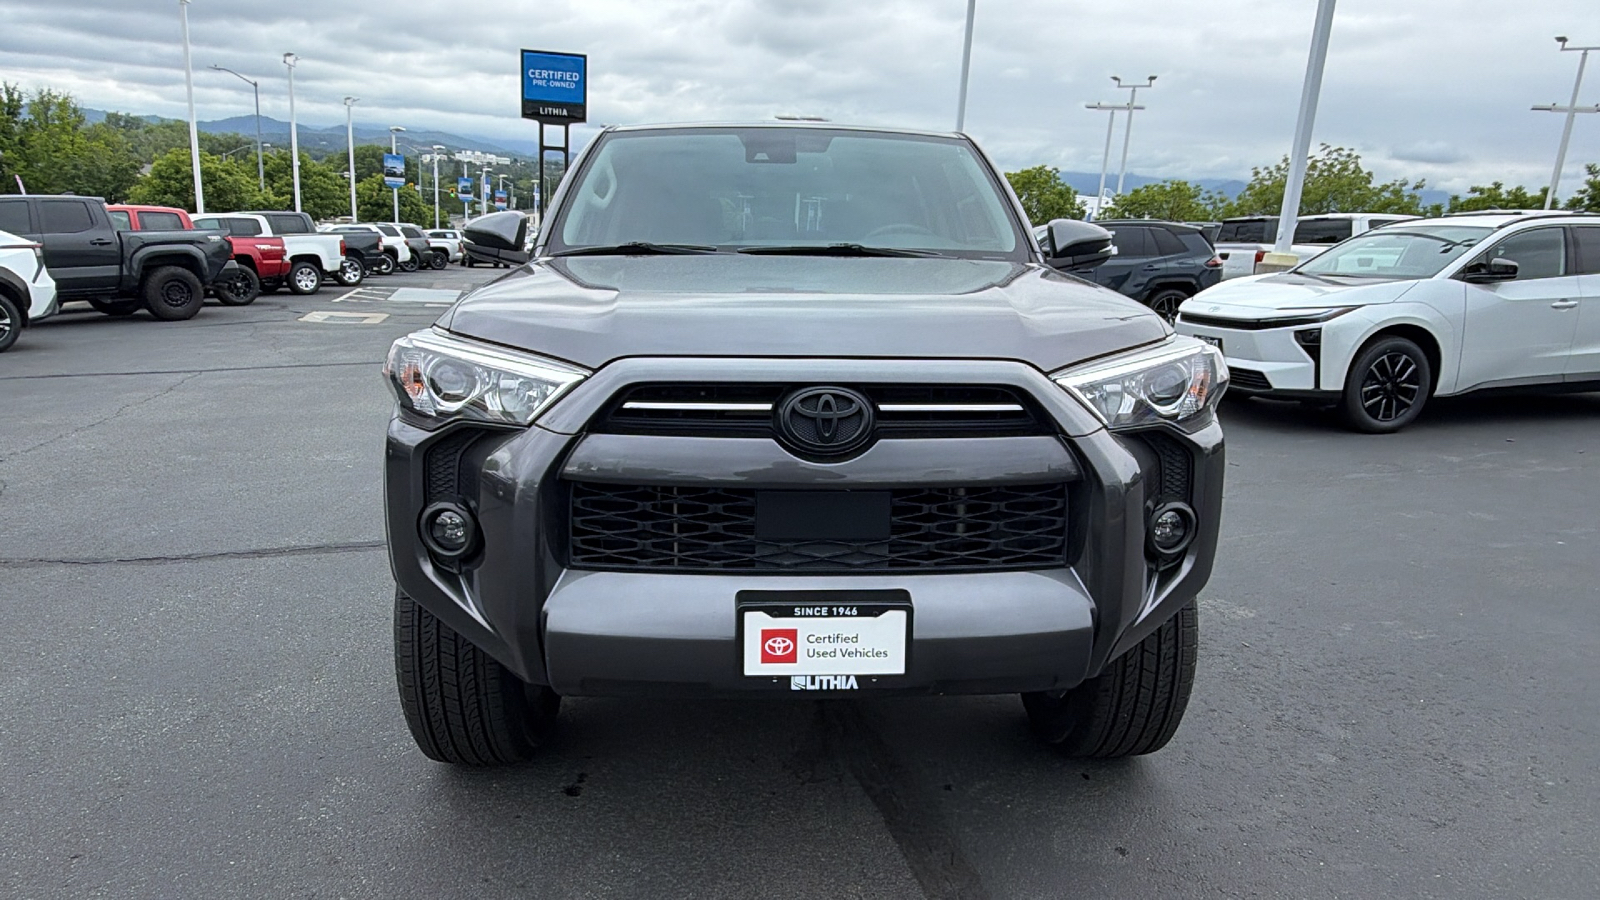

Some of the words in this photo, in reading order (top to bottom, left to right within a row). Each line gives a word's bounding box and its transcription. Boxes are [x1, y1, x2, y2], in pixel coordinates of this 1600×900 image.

[528, 69, 580, 81] CERTIFIED
[533, 79, 575, 88] PRE-OWNED
[539, 107, 568, 116] LITHIA
[794, 607, 828, 616] SINCE
[832, 607, 858, 616] 1946
[806, 633, 859, 644] Certified
[806, 648, 837, 658] Used
[839, 648, 888, 658] Vehicles
[806, 675, 858, 690] LITHIA
